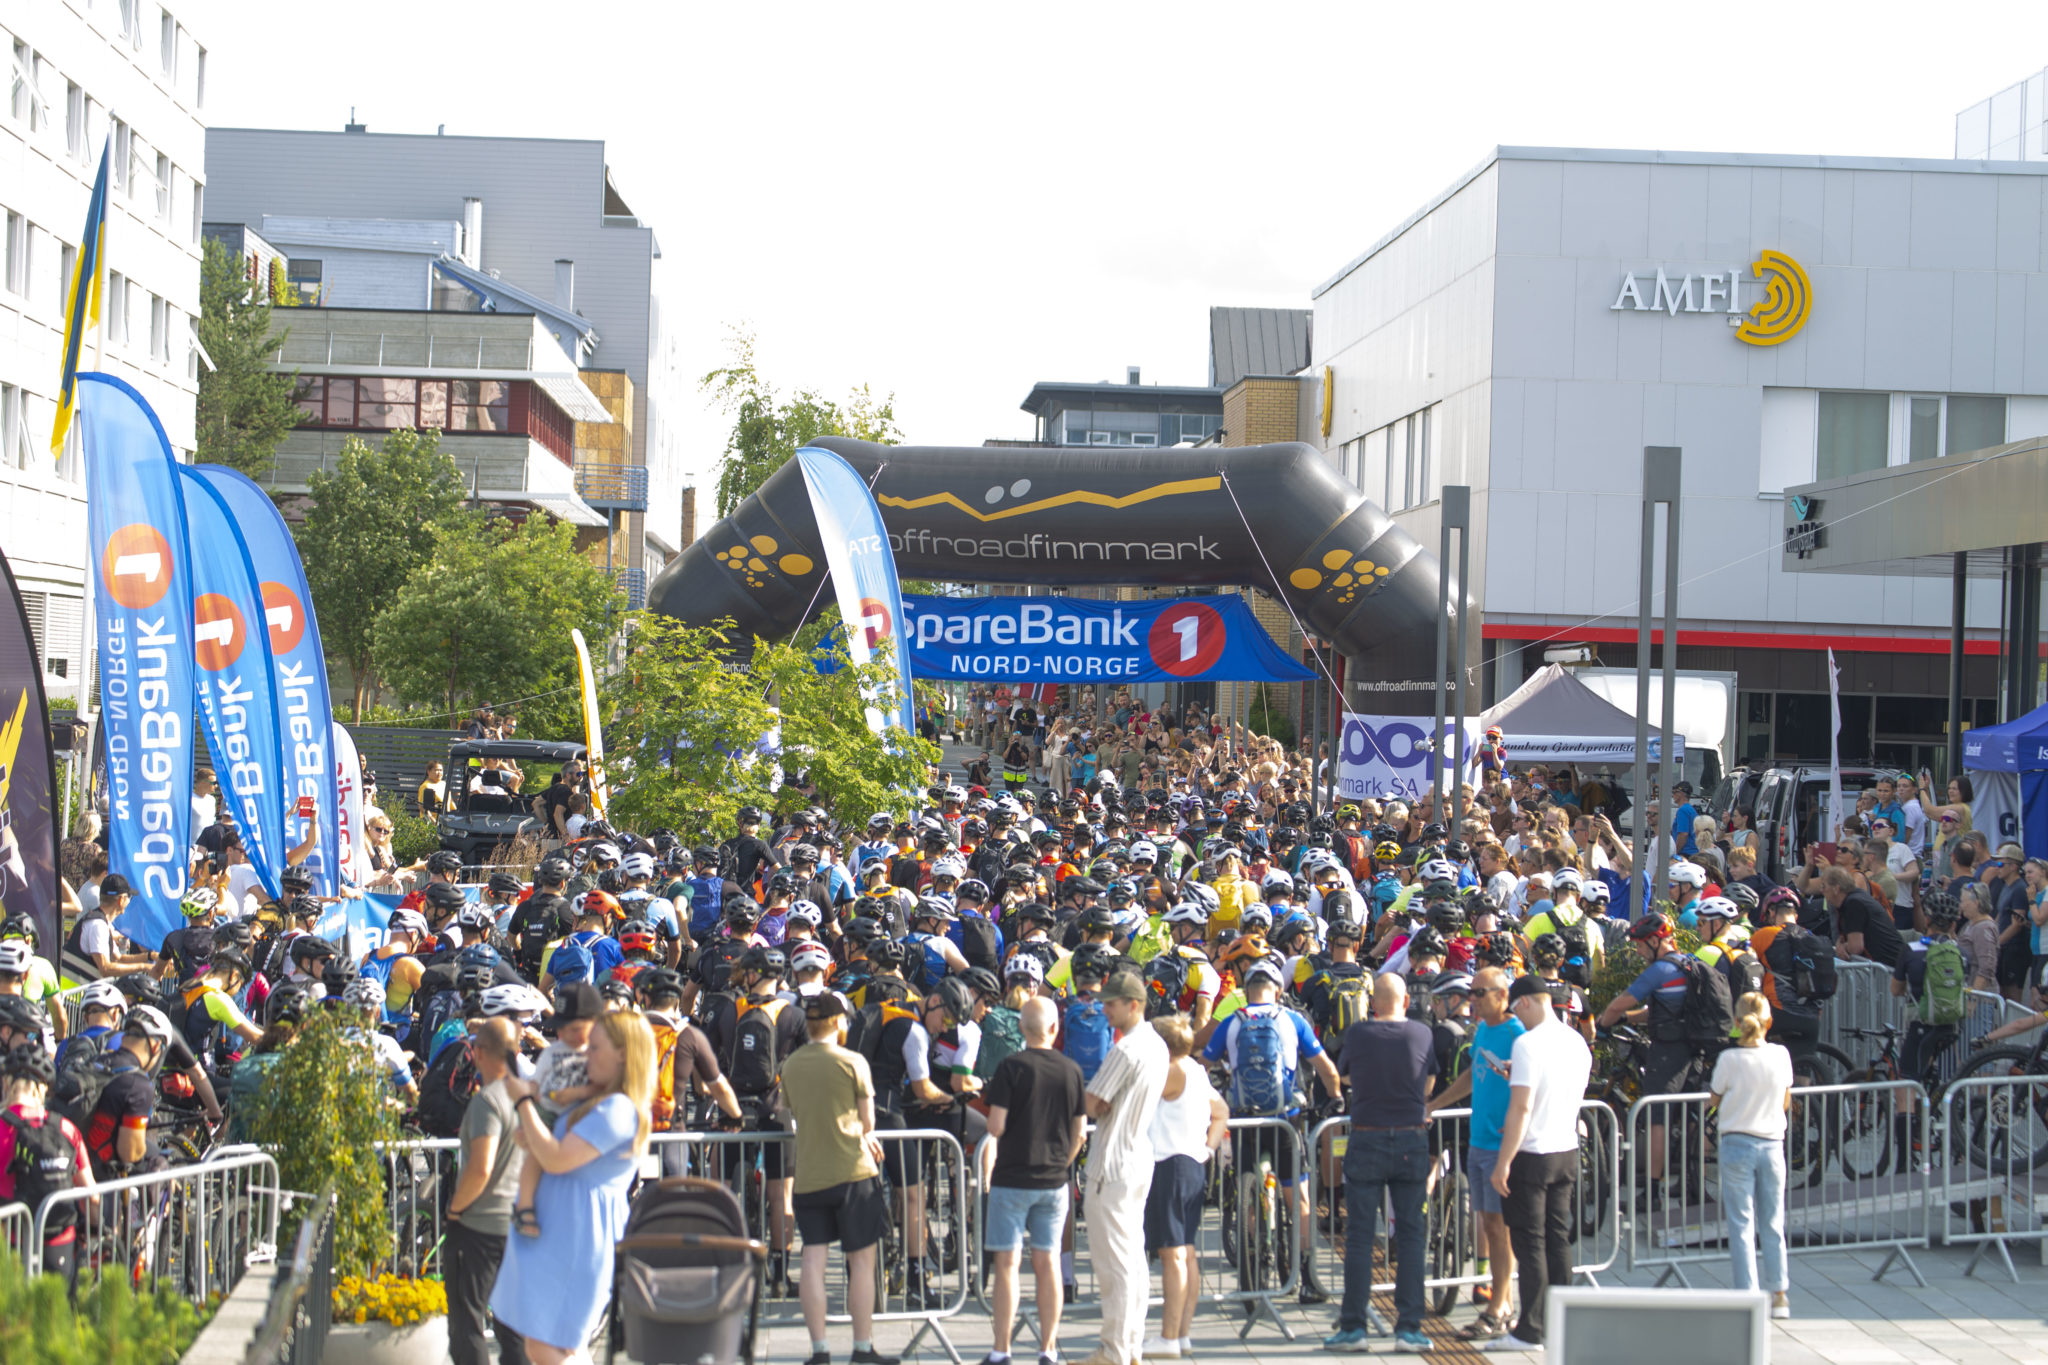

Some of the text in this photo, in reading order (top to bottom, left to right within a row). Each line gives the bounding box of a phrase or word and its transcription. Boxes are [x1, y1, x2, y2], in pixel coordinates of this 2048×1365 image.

[1610, 267, 1743, 317] AMFI
[1172, 615, 1200, 663] 1
[951, 655, 1140, 677] NORD-NORGE
[1340, 719, 1471, 781] oop
[1391, 777, 1419, 797] SA
